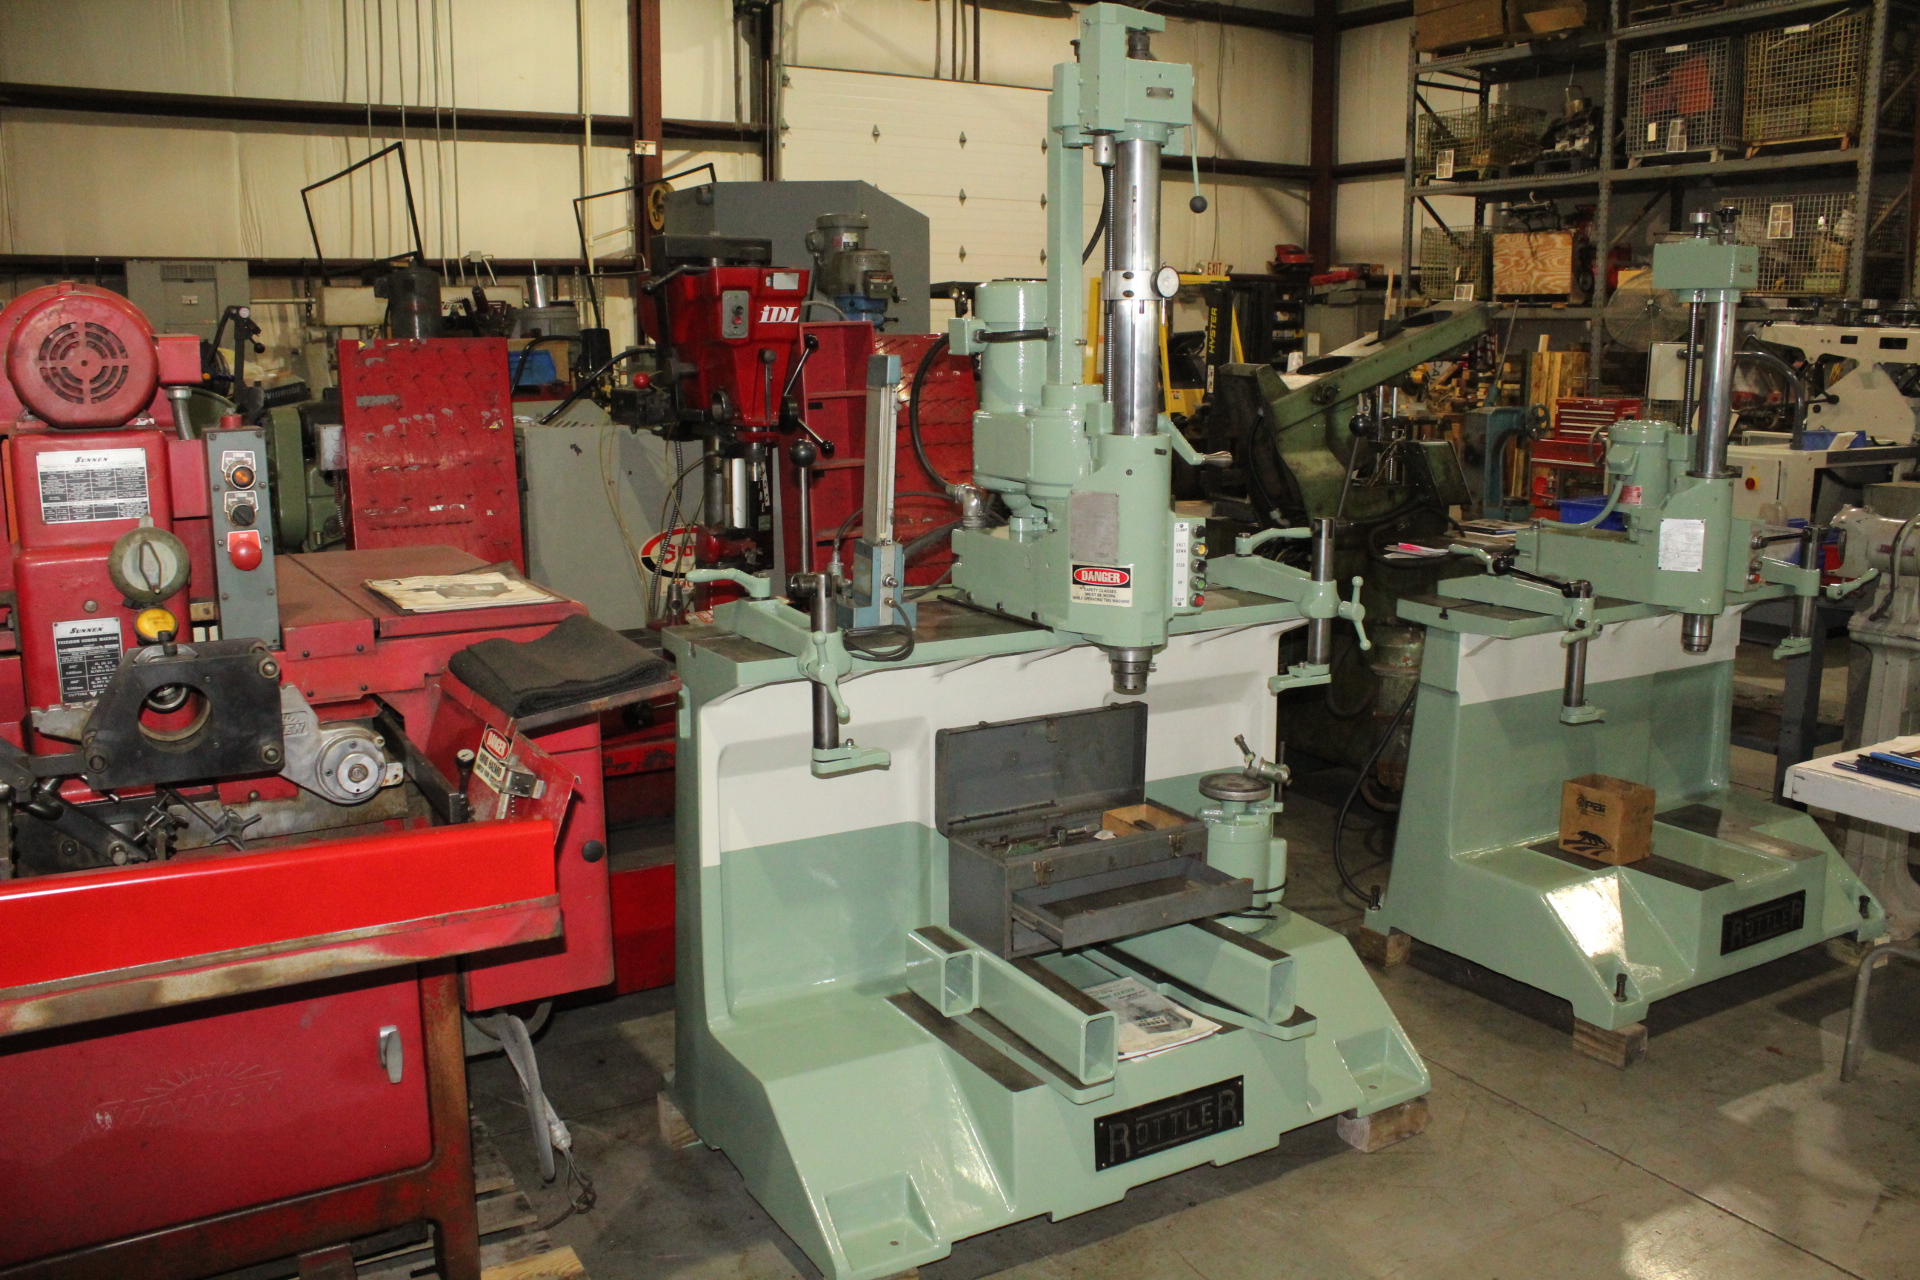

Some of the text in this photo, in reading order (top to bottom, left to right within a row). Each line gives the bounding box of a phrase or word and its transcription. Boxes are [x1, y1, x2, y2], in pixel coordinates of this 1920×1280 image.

[1207, 262, 1222, 276] EXIT
[1208, 307, 1218, 354] HYSTER
[1081, 570, 1121, 584] DANGER
[1731, 899, 1803, 947] ROTTLER
[1108, 1089, 1238, 1163] ROTTLER
